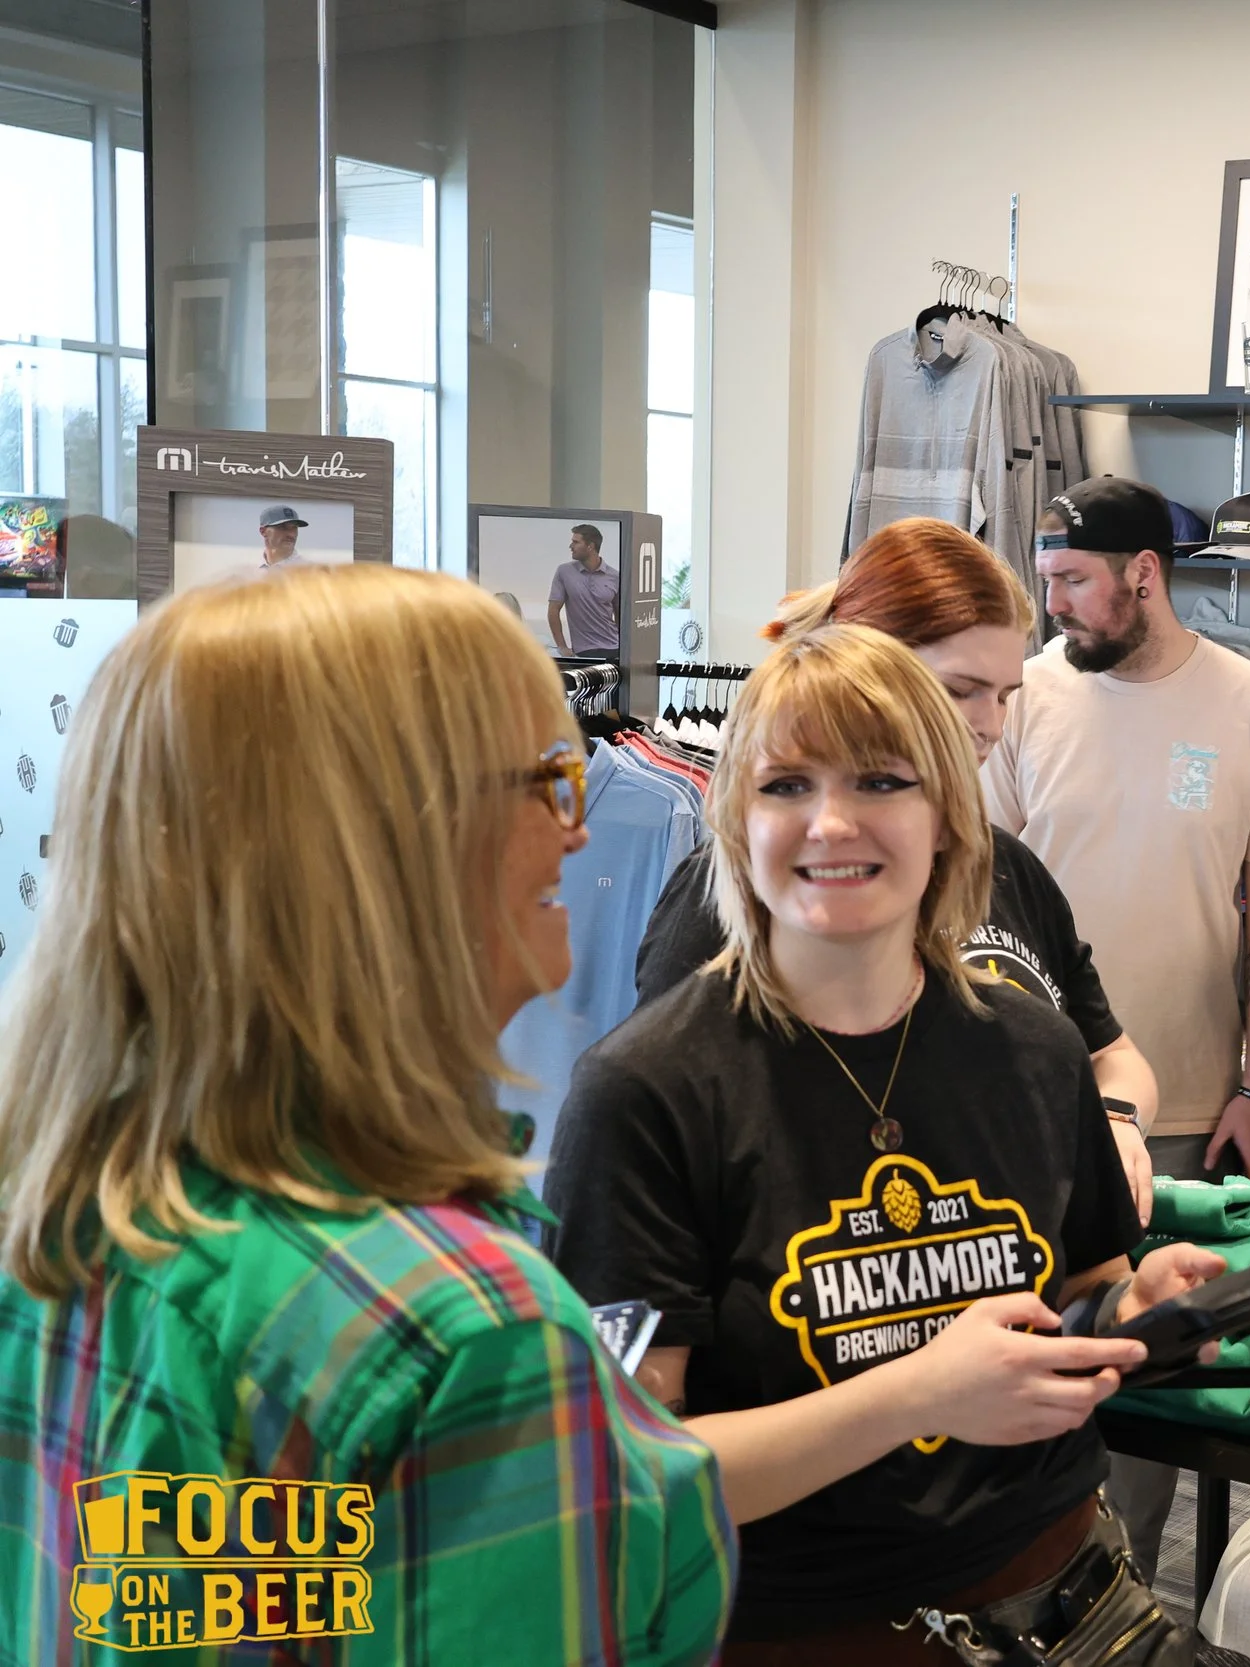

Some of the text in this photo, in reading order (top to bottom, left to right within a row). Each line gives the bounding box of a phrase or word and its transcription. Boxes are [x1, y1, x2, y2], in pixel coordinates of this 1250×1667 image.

[849, 1195, 969, 1237] EST. 2021
[811, 1233, 1026, 1319] HACKAMORE
[835, 1323, 920, 1364] BREWING
